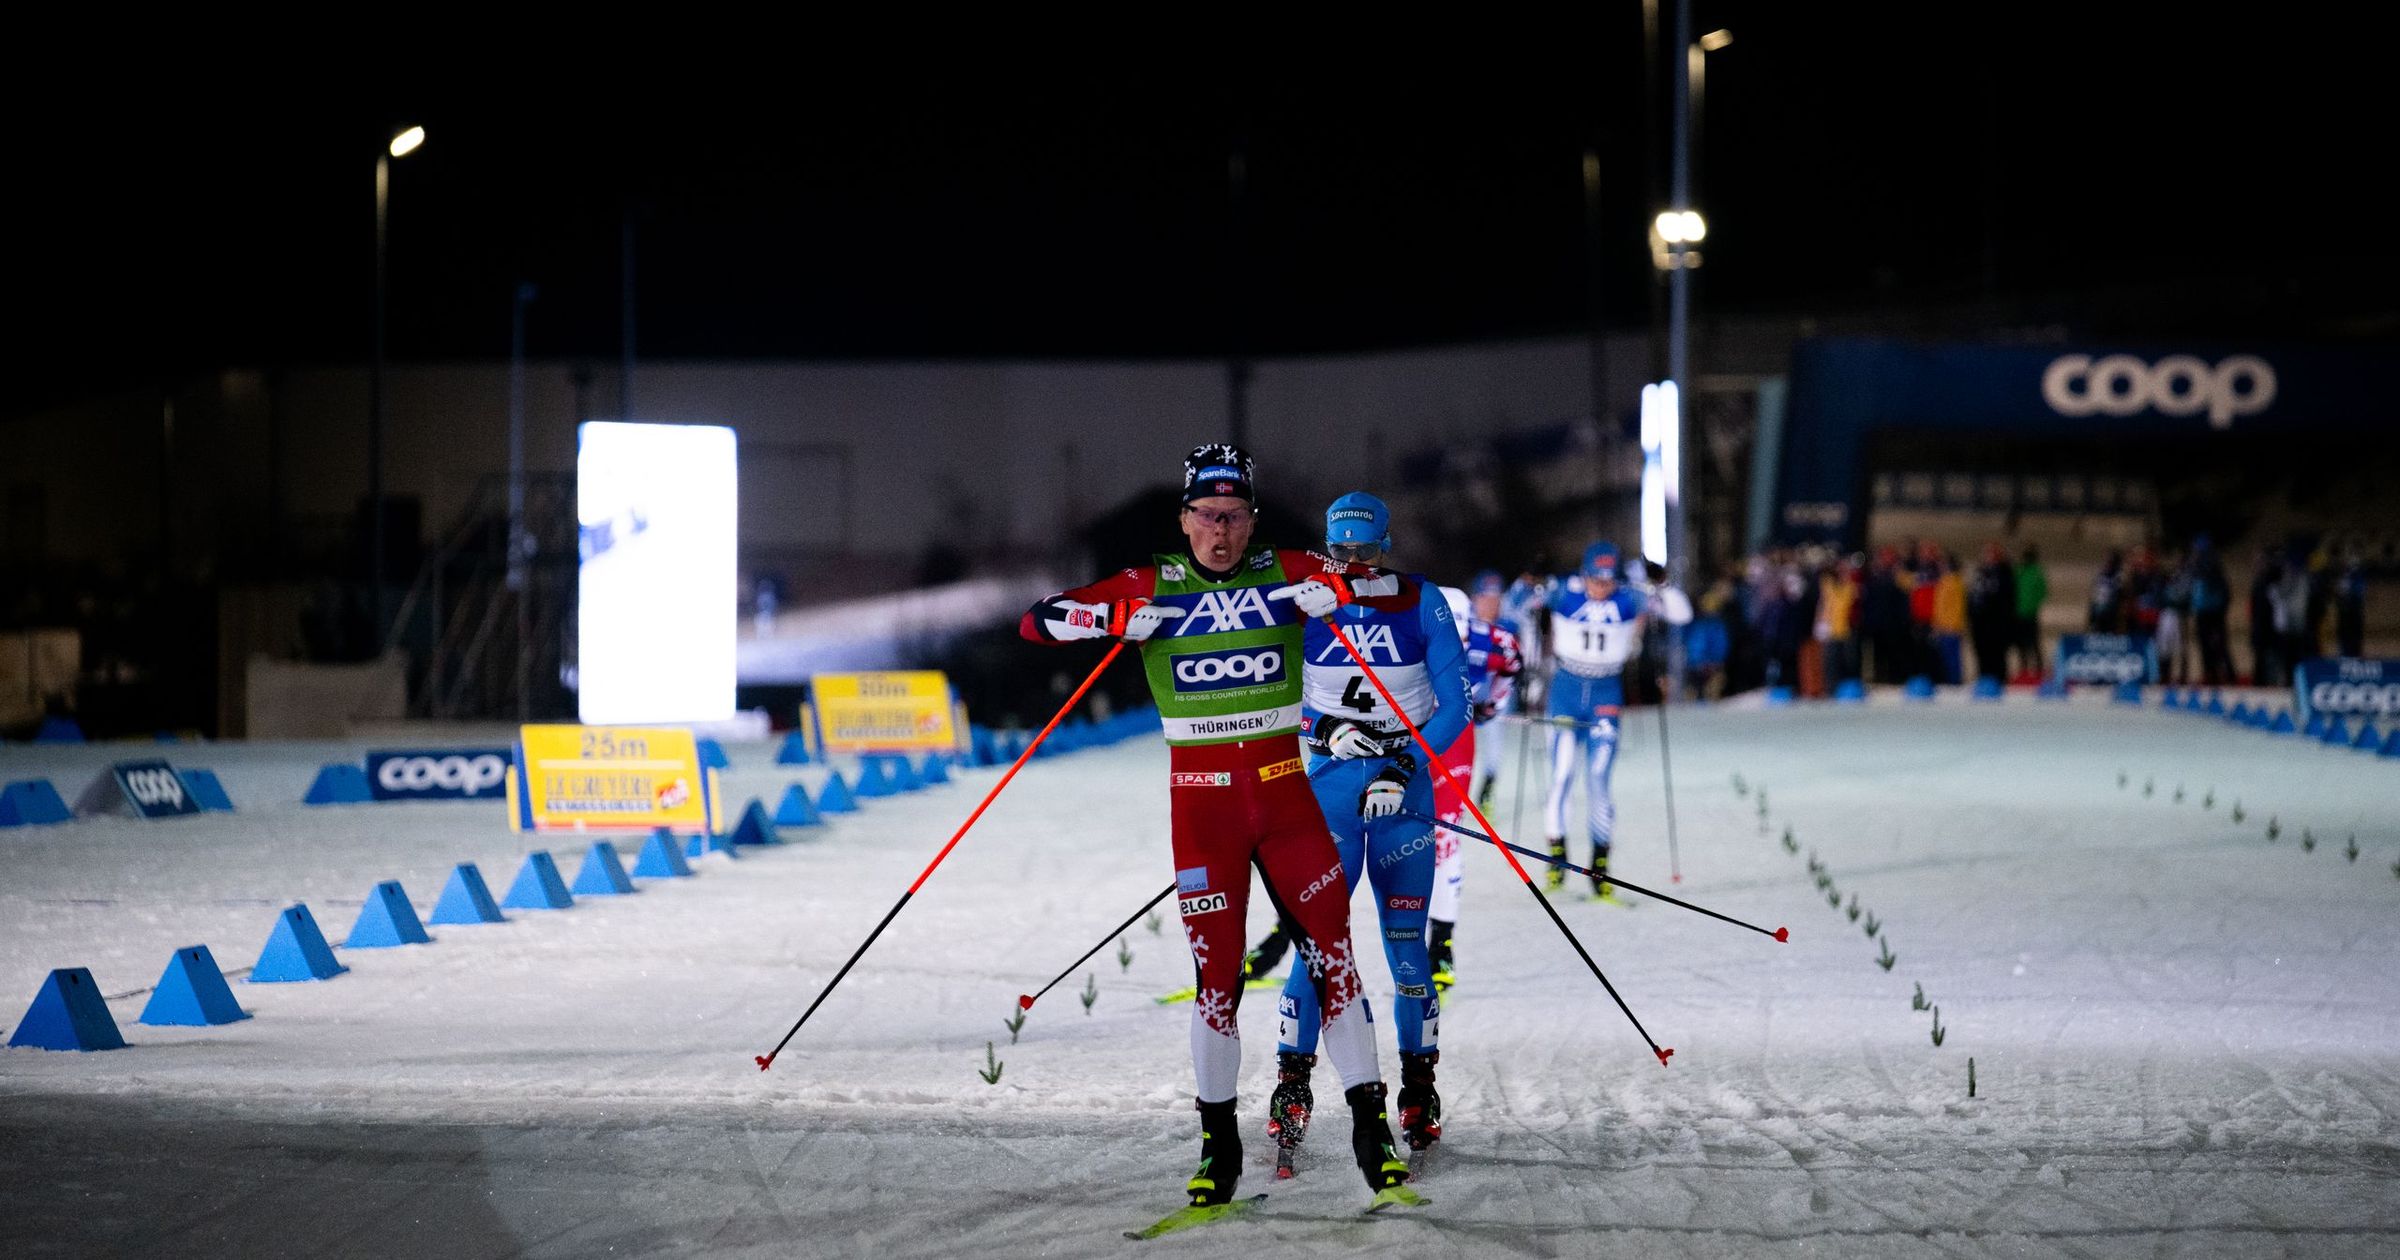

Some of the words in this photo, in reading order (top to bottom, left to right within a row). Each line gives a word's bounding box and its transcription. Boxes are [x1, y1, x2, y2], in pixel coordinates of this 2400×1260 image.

[2041, 353, 2277, 429] coop
[1198, 468, 1240, 480] SpareBank
[1174, 587, 1277, 636] AXA
[1316, 624, 1402, 663] AXA
[1582, 631, 1607, 651] 11
[1176, 651, 1281, 683] coop
[1211, 690, 1247, 699] COUNTRY
[1249, 686, 1275, 695] WORLD
[1341, 676, 1376, 713] 4
[1190, 716, 1263, 734] THÜRINGEN
[581, 731, 648, 758] 25m
[127, 768, 183, 810] coop
[379, 754, 503, 795] coop
[1176, 774, 1215, 784] SPAR
[1299, 862, 1343, 902] CRAFT
[1390, 898, 1422, 909] enel
